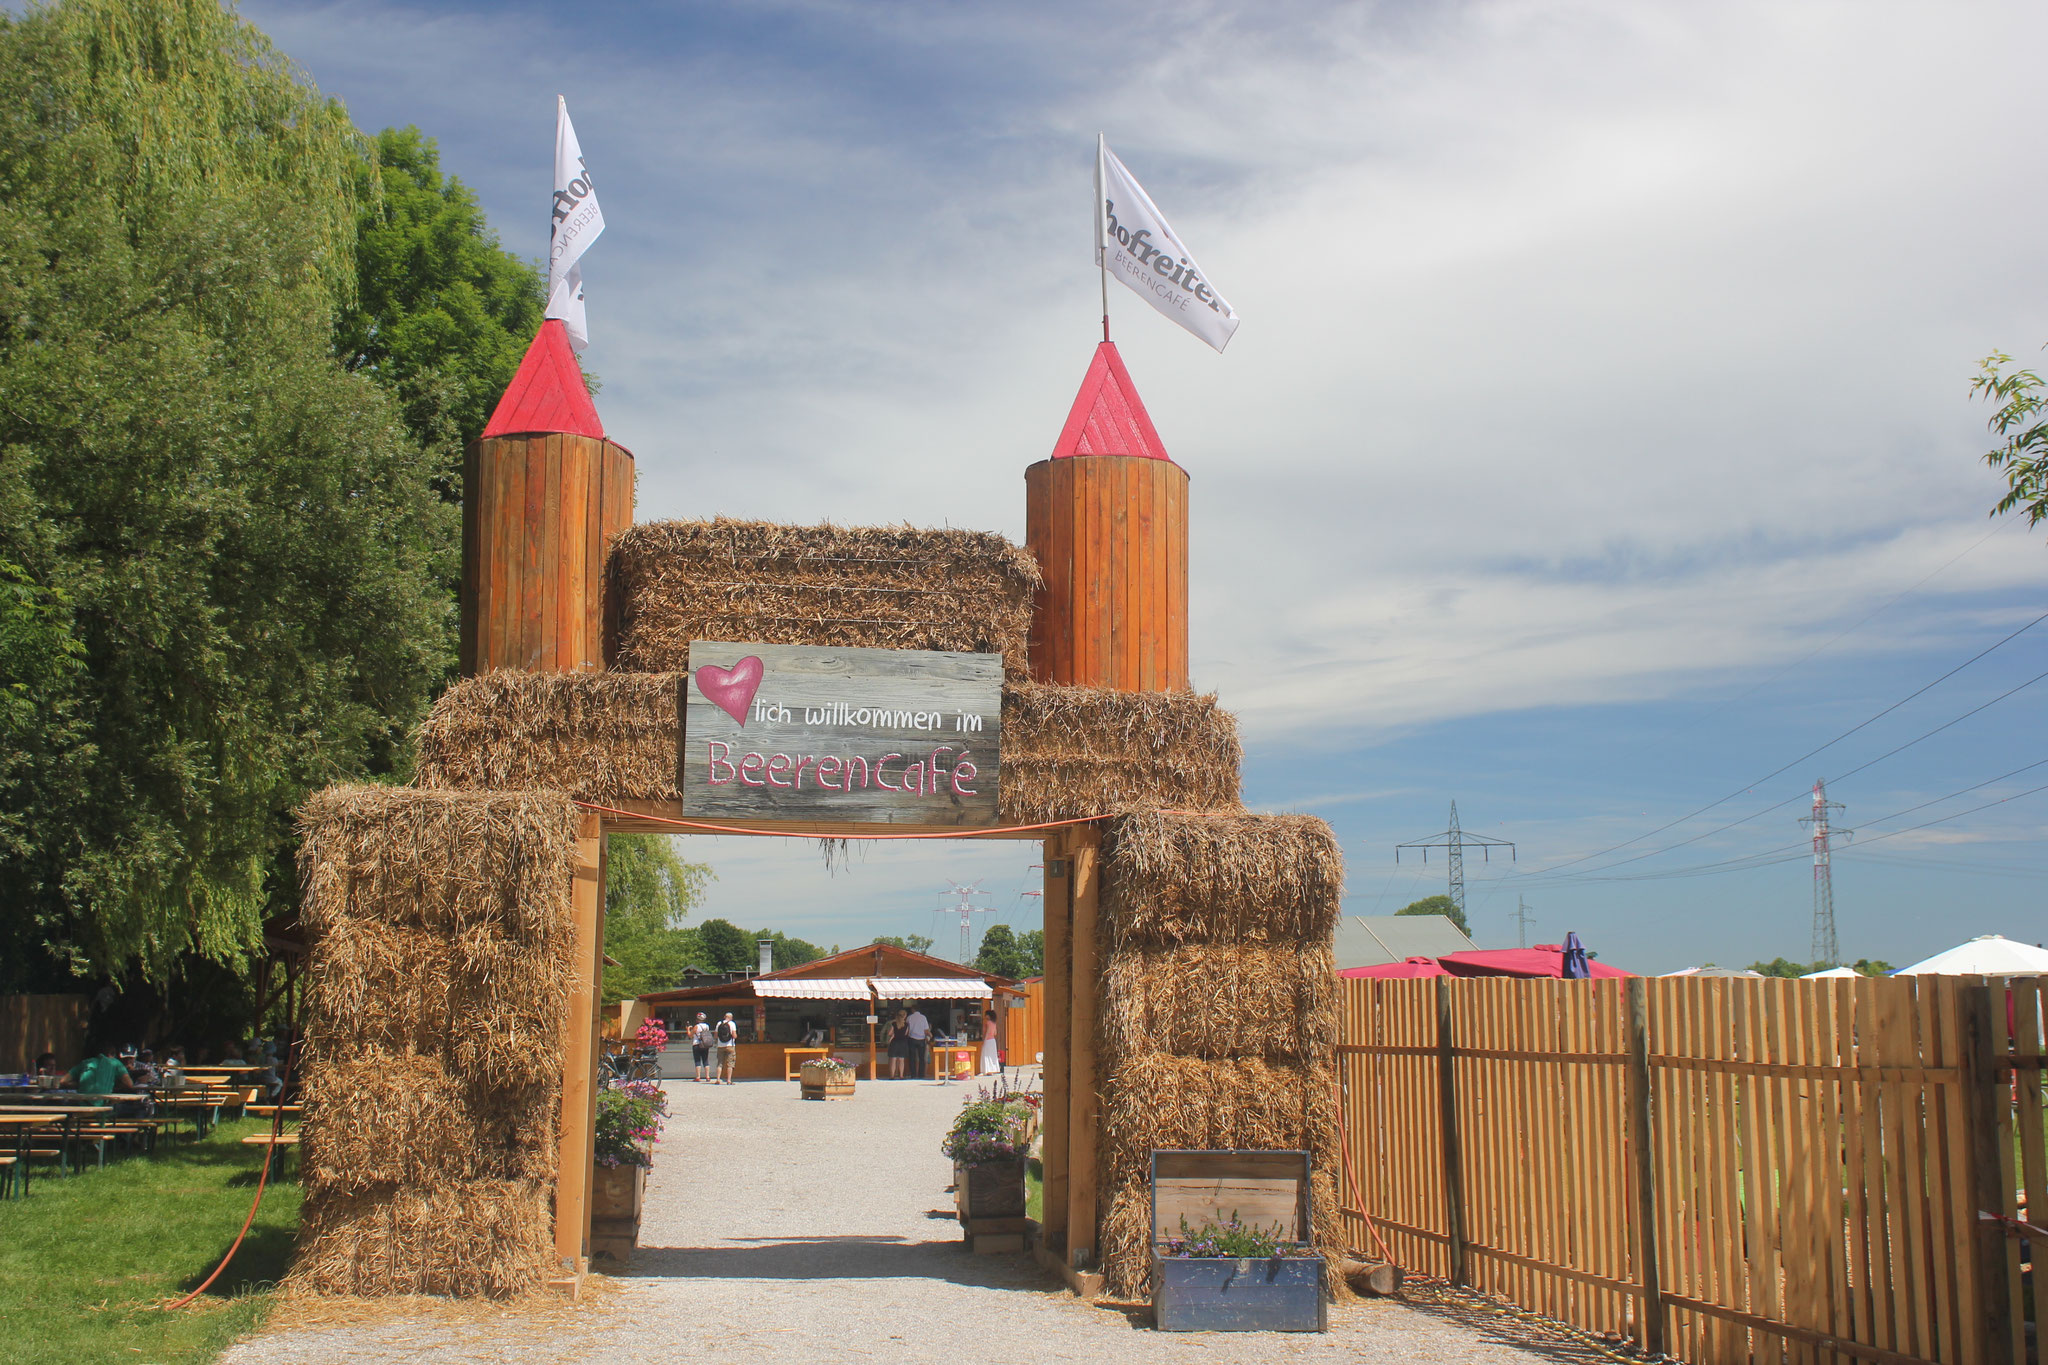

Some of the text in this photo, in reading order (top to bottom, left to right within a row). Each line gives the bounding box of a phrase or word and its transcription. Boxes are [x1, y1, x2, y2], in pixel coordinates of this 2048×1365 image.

[1115, 250, 1192, 312] BEERENCAFÉ
[755, 699, 982, 732] lich willkommen im
